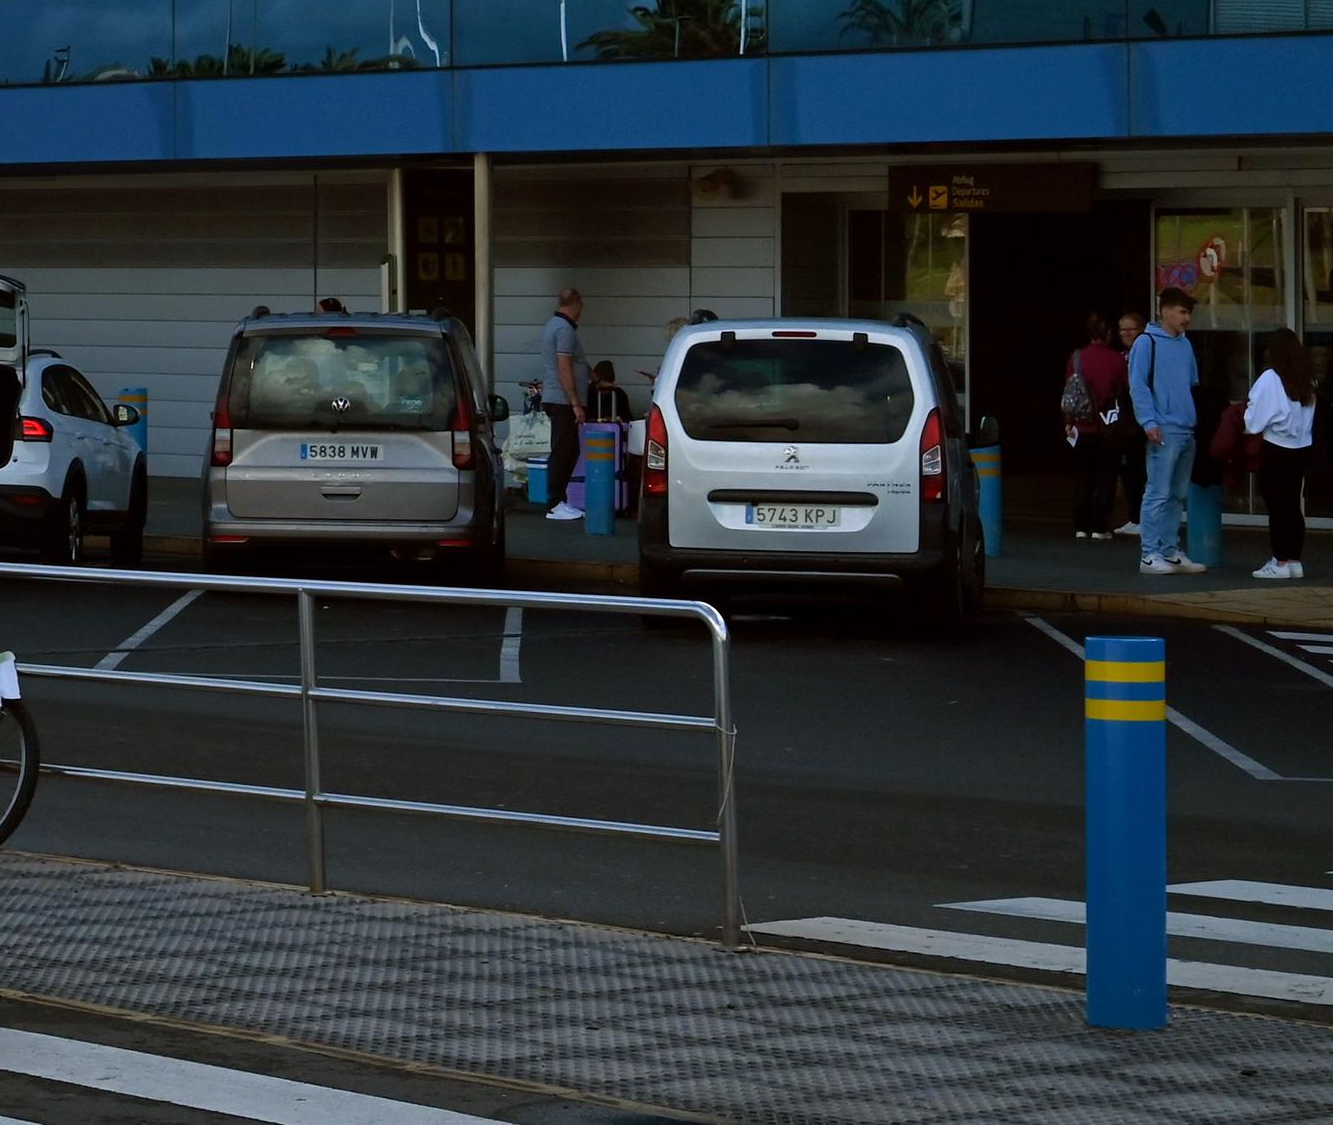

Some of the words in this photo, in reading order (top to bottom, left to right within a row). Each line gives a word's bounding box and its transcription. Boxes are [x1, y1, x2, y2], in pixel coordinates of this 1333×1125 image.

[952, 187, 990, 197] Departures
[952, 197, 985, 208] Salidas
[309, 445, 347, 459] 5838
[350, 446, 379, 459] MVW
[756, 508, 799, 523] 5743
[804, 508, 837, 524] KPJ
